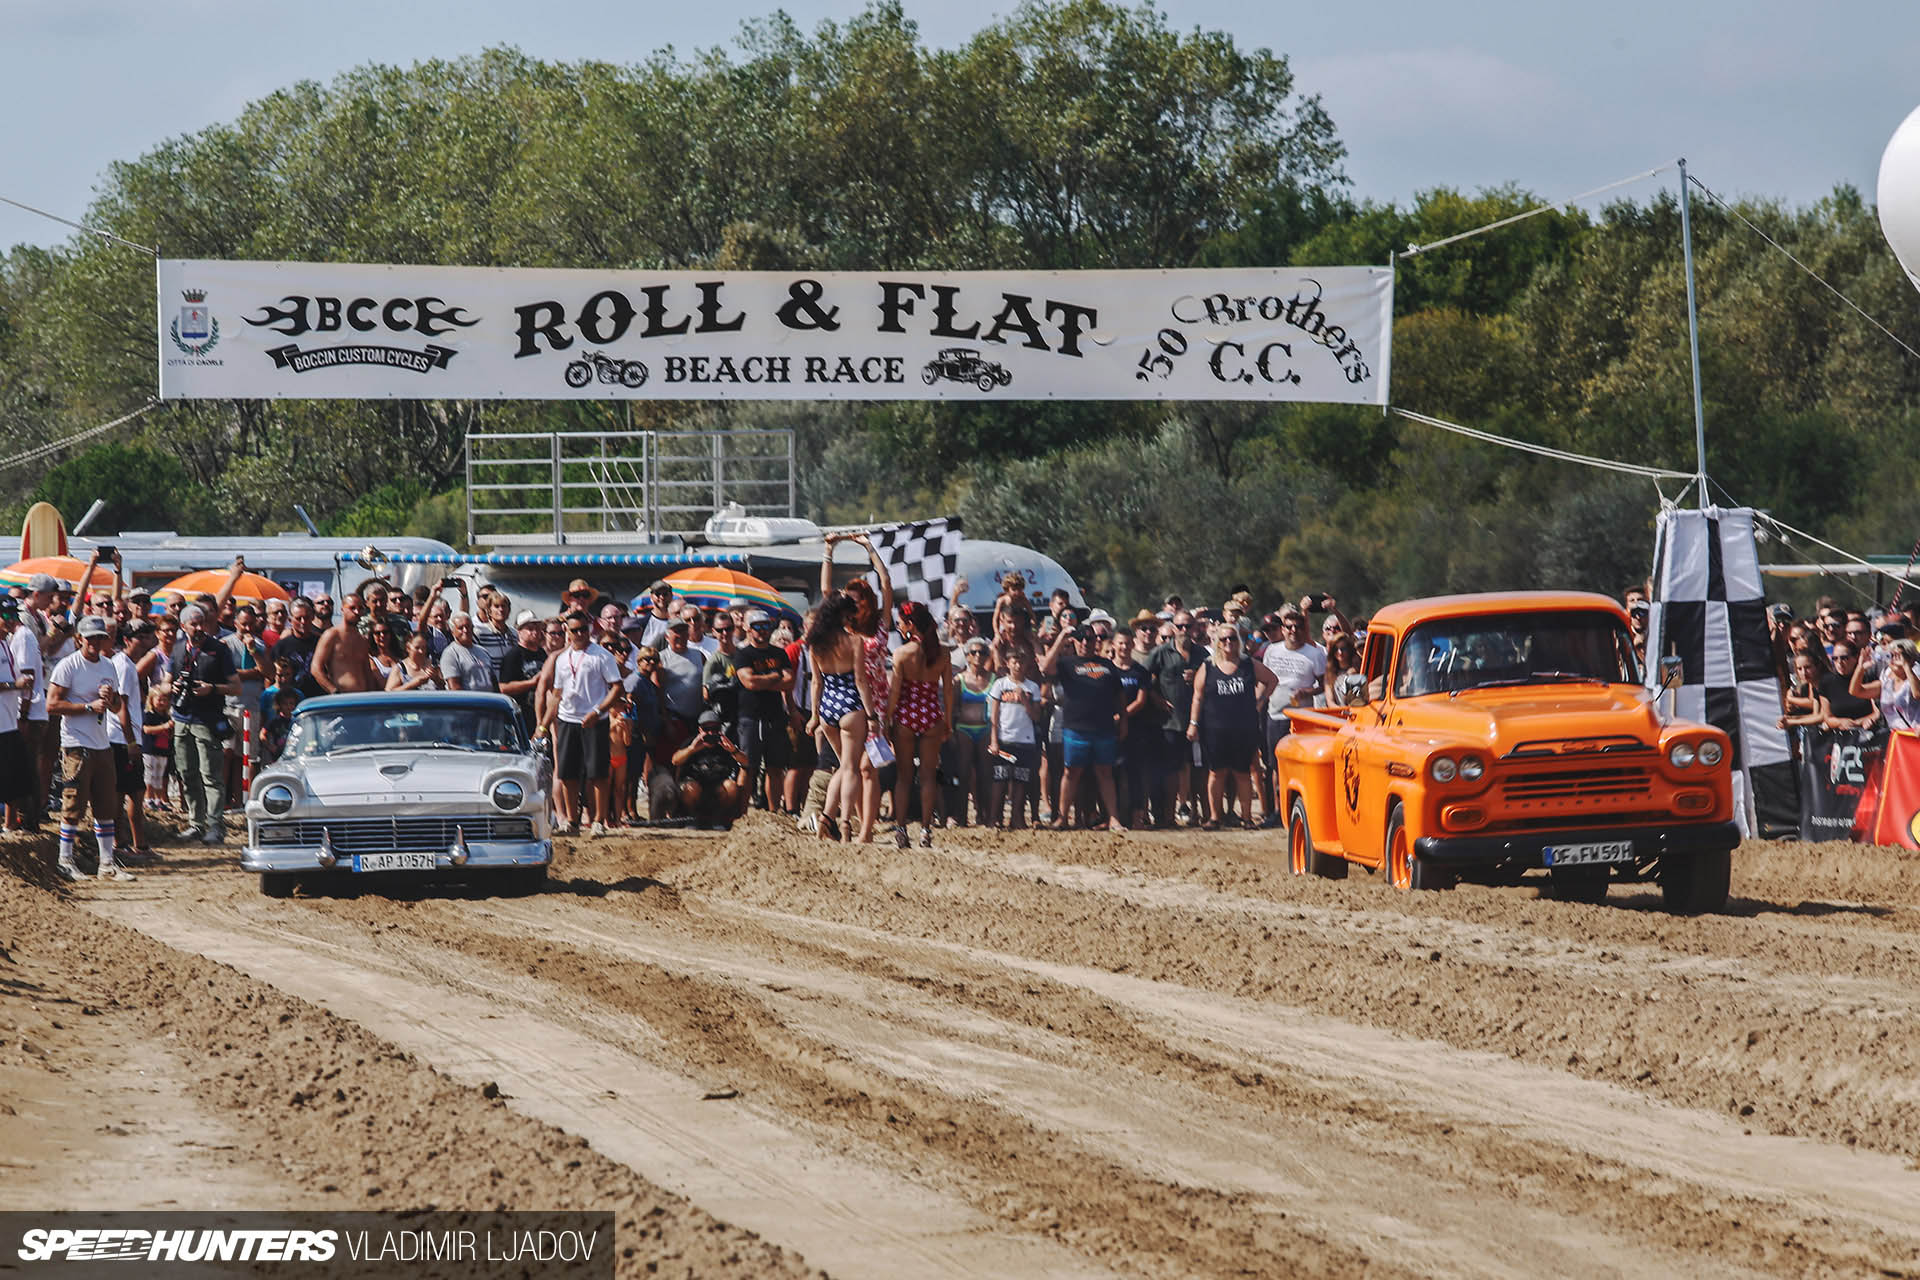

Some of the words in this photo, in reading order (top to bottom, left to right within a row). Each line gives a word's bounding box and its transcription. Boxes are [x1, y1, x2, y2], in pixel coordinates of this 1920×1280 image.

[514, 281, 746, 359] ROLL
[775, 279, 840, 332] &
[877, 281, 1097, 358] FLAT
[1171, 278, 1371, 383] Brothers
[294, 350, 337, 371] BOCCIN
[338, 348, 385, 363] CUSTOM
[387, 350, 429, 371] CYCLES
[664, 356, 791, 383] BEACH
[804, 356, 904, 383] RACE
[1208, 341, 1301, 385] C.C.
